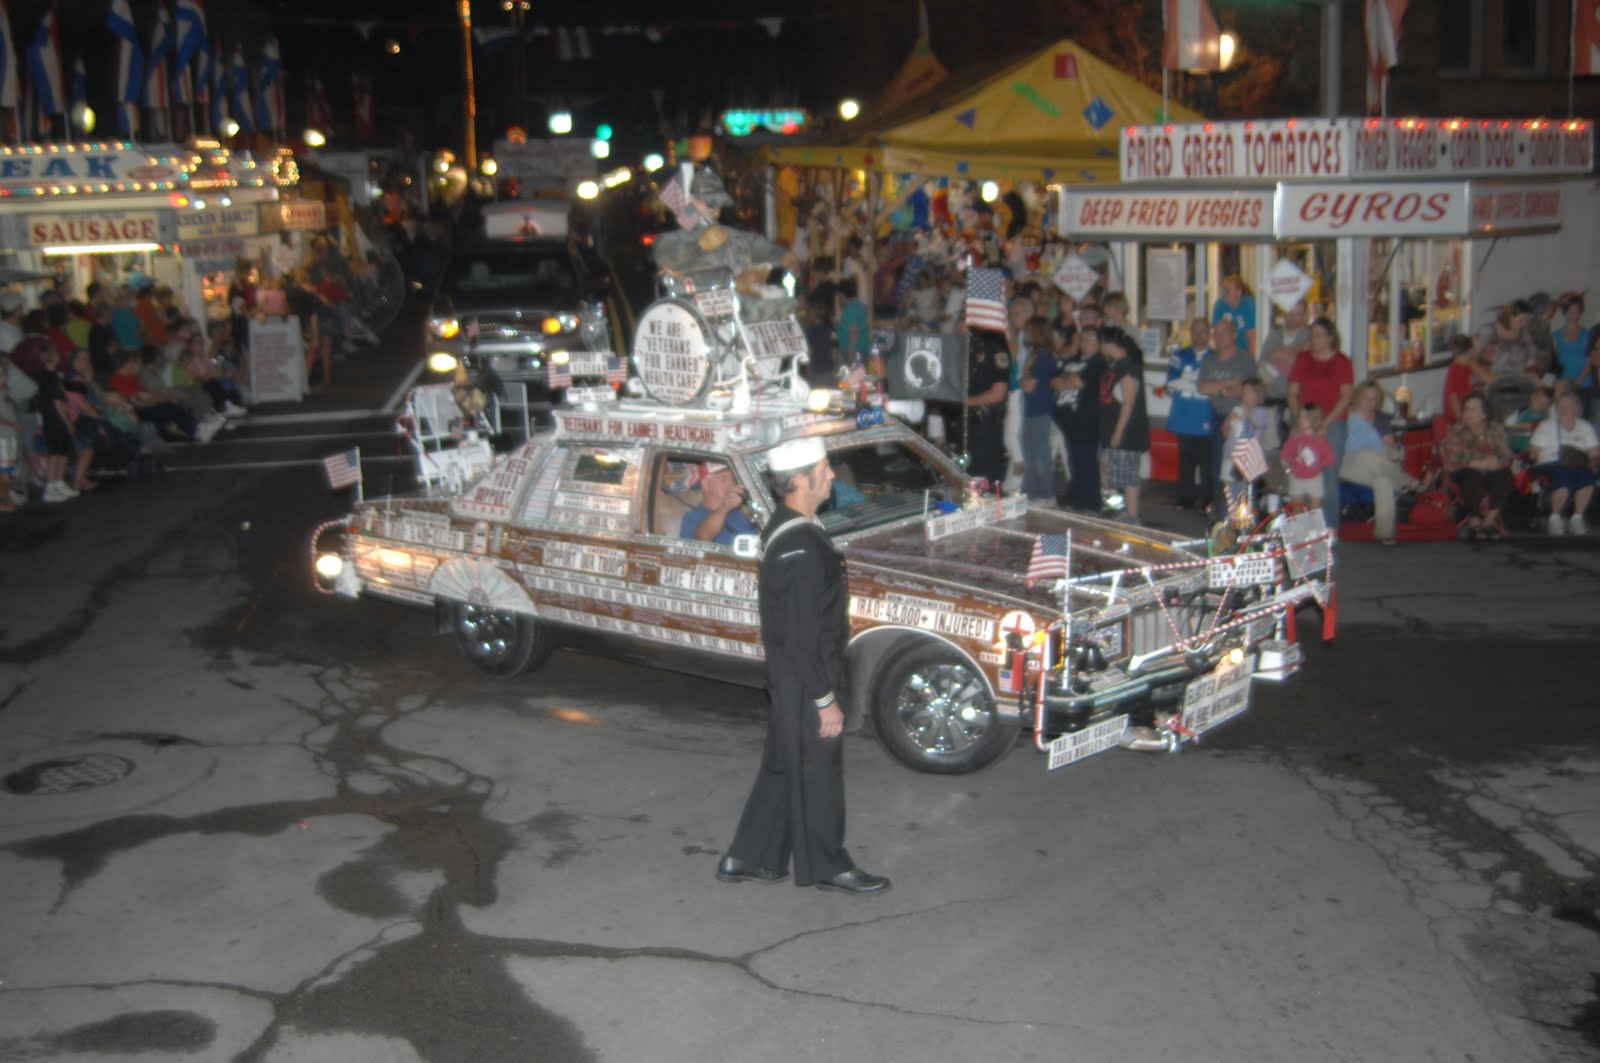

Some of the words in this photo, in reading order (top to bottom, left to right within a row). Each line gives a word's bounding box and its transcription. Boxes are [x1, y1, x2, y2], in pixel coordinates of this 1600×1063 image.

[1126, 136, 1172, 178] FRIED
[1182, 133, 1235, 176] GREEN
[1244, 129, 1342, 175] TOMATOES
[1079, 198, 1123, 226] DEEP
[1127, 199, 1179, 227] FRIED
[1184, 199, 1263, 228] VEGGIES
[1300, 192, 1450, 228] GYROS
[32, 220, 157, 244] SAUSAGE
[934, 612, 988, 639] INJURED!
